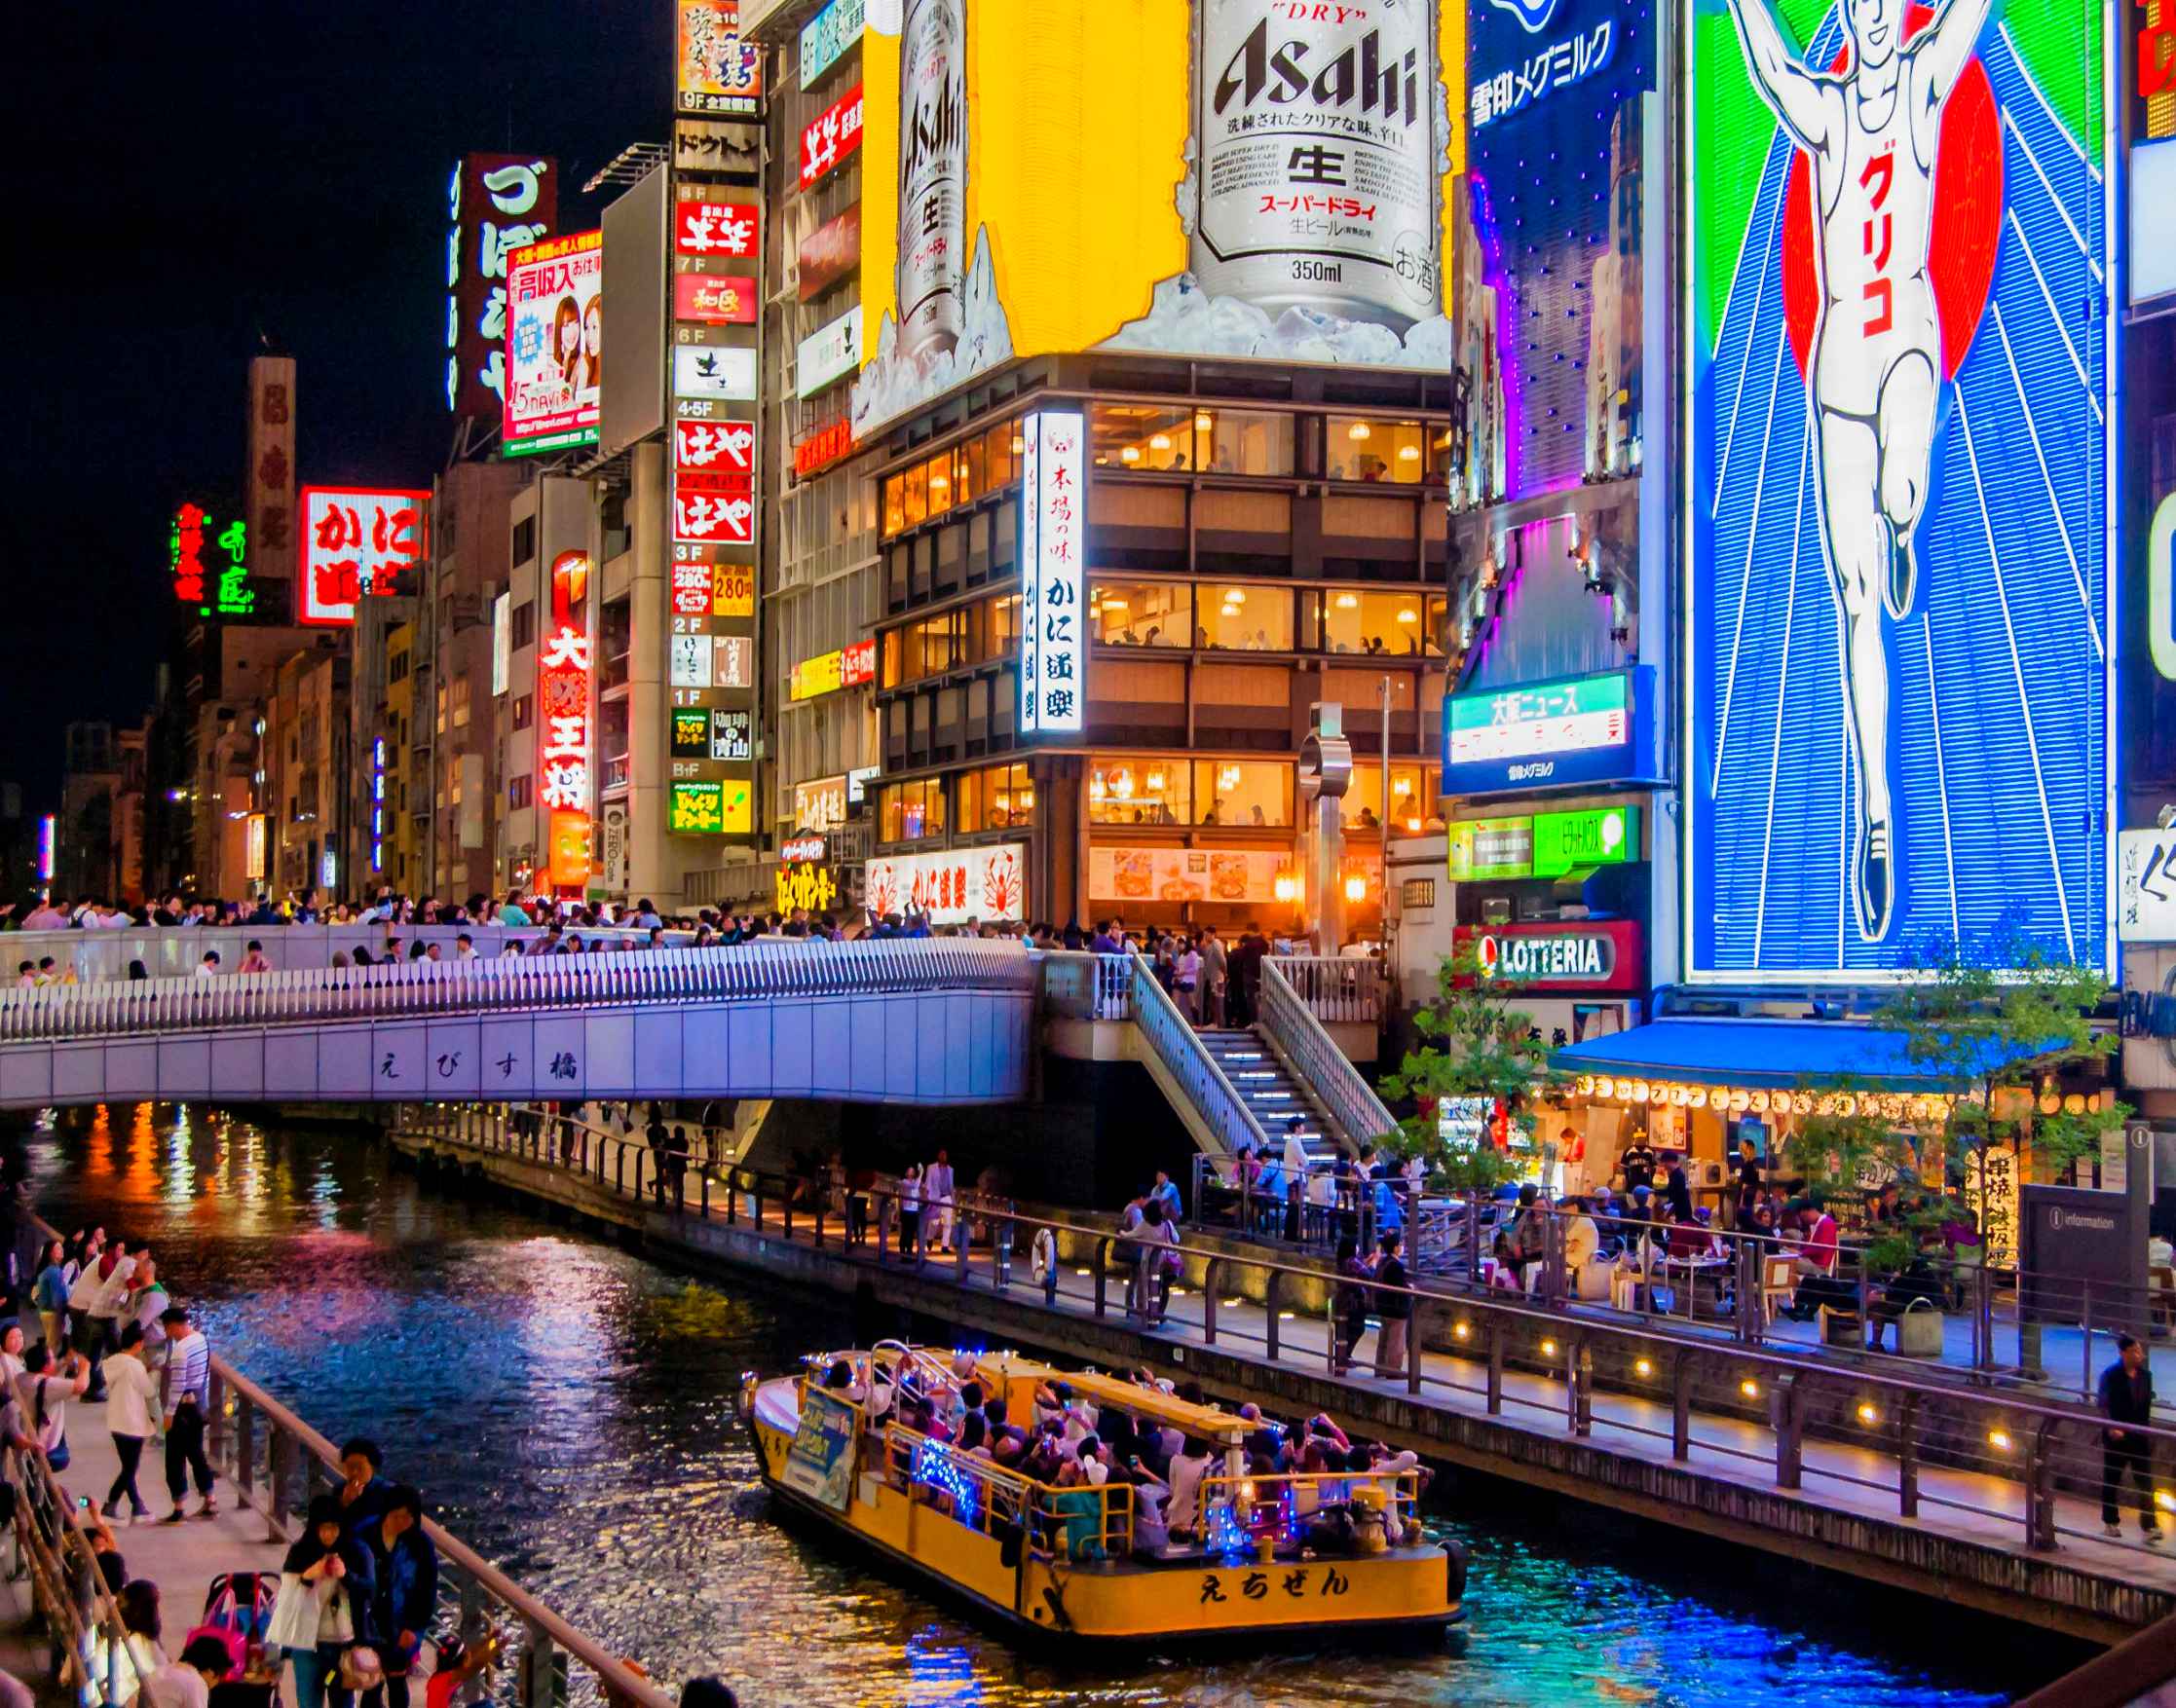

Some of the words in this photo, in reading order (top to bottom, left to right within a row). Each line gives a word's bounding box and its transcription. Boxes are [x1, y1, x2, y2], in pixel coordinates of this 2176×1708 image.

[1215, 17, 1416, 128] Asahi
[1471, 20, 1611, 128] 雪印メグミルク
[684, 92, 704, 109] 9F
[904, 69, 960, 198] Asahi
[1288, 145, 1346, 187] 生
[922, 195, 939, 237] 生
[1259, 195, 1376, 221] スーパードライ
[1858, 138, 1896, 339] グリコ
[1292, 261, 1342, 283] 350ml
[1395, 247, 1434, 295] お酒
[677, 425, 752, 466] はや
[315, 502, 421, 554] かに
[676, 495, 752, 538] はや
[1049, 464, 1072, 566] 本場の味
[716, 577, 752, 600] 280円
[674, 618, 702, 633] 2F
[1045, 577, 1074, 719] かに道楽
[674, 689, 701, 705] 1F
[1491, 686, 1578, 724] 大阪ニュース
[714, 713, 748, 728] 珈琲
[725, 727, 738, 740] の
[714, 738, 748, 758] 青山
[673, 763, 700, 777] B1F
[1500, 939, 1601, 974] LOTTERIA
[381, 1051, 578, 1081] えびす橋
[2063, 1215, 2115, 1231] information
[1199, 1567, 1350, 1605] えちぜん
